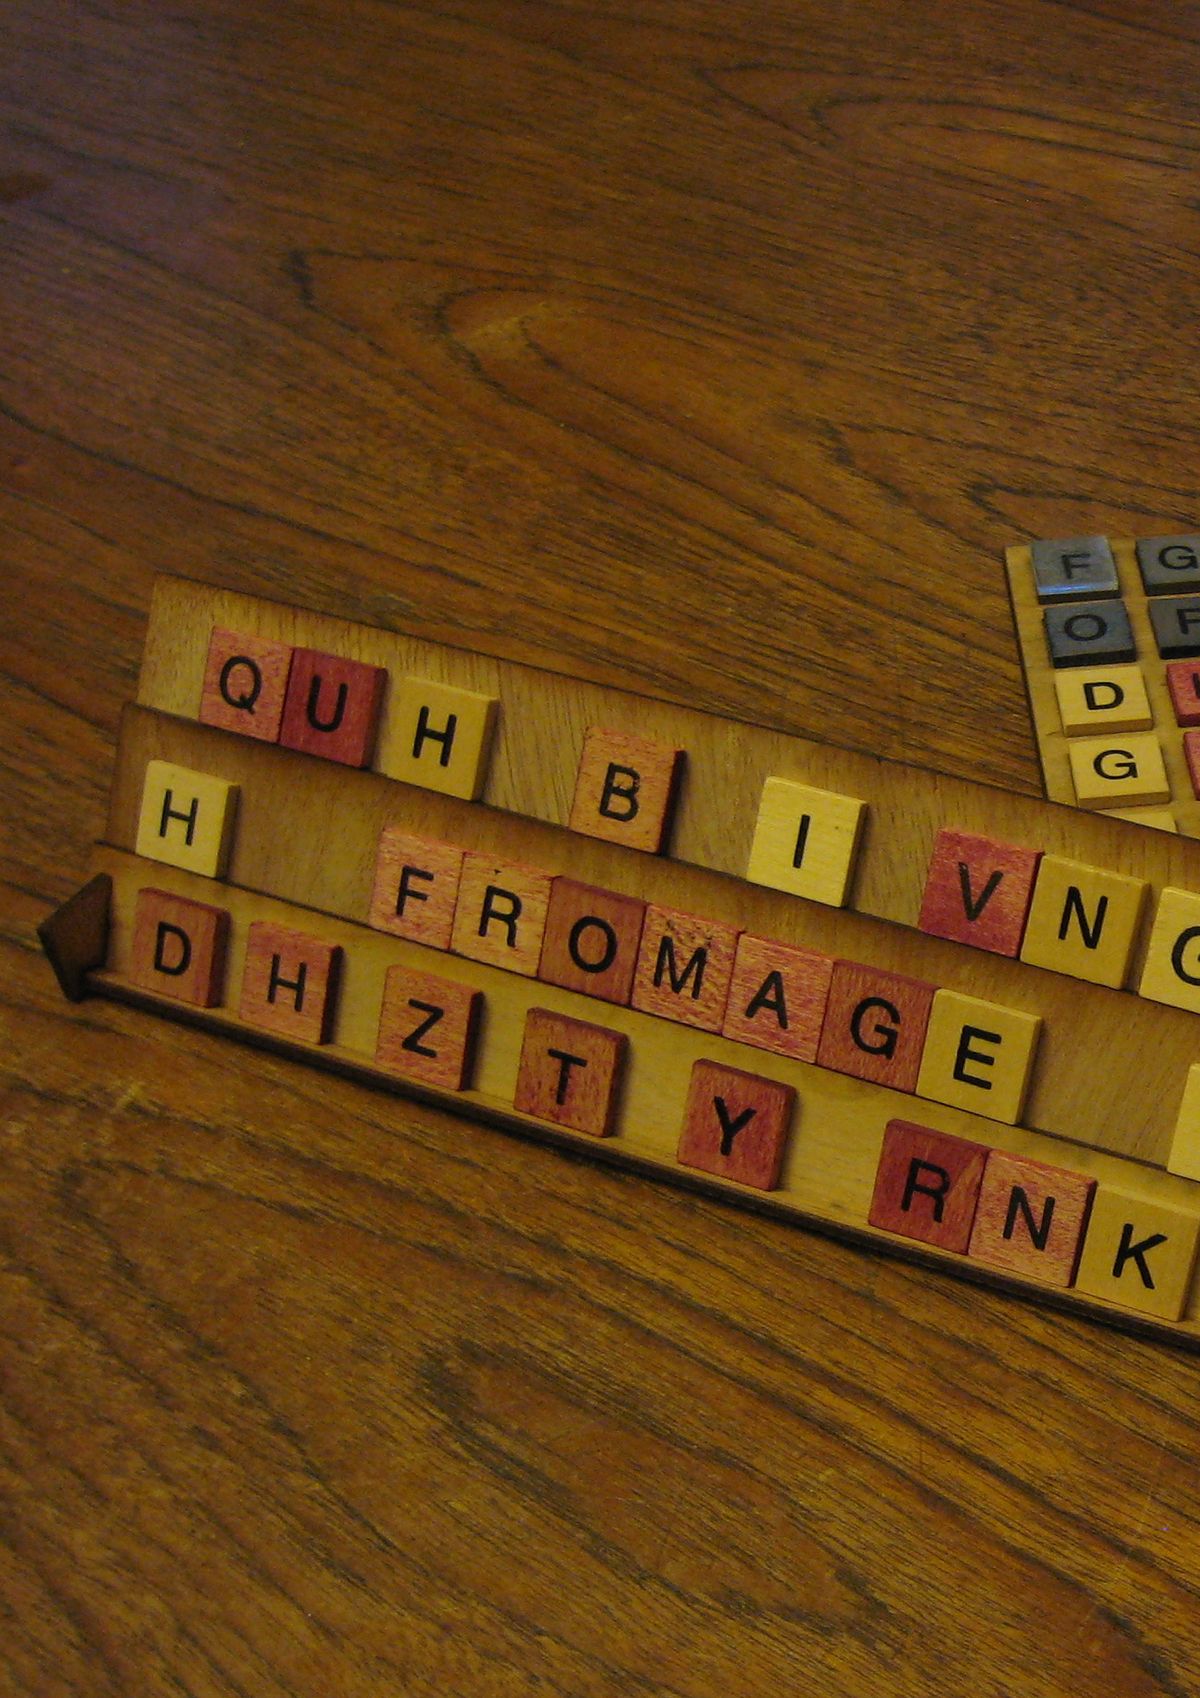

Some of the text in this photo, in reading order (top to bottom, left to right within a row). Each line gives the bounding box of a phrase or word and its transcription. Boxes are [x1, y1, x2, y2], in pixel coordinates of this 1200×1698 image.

[1064, 553, 1091, 579] F
[1157, 545, 1200, 571] G
[1063, 613, 1109, 642] O
[1083, 681, 1124, 711] D
[1092, 750, 1138, 780] G
[412, 704, 458, 767] H
[599, 762, 641, 824] B
[795, 814, 811, 869] I
[159, 788, 198, 846] H
[394, 866, 1002, 1090] FROMAGE
[152, 922, 192, 976] D
[267, 953, 308, 1012] H
[401, 998, 446, 1059] Z
[548, 1048, 588, 1107] T
[714, 1095, 755, 1157] Y
